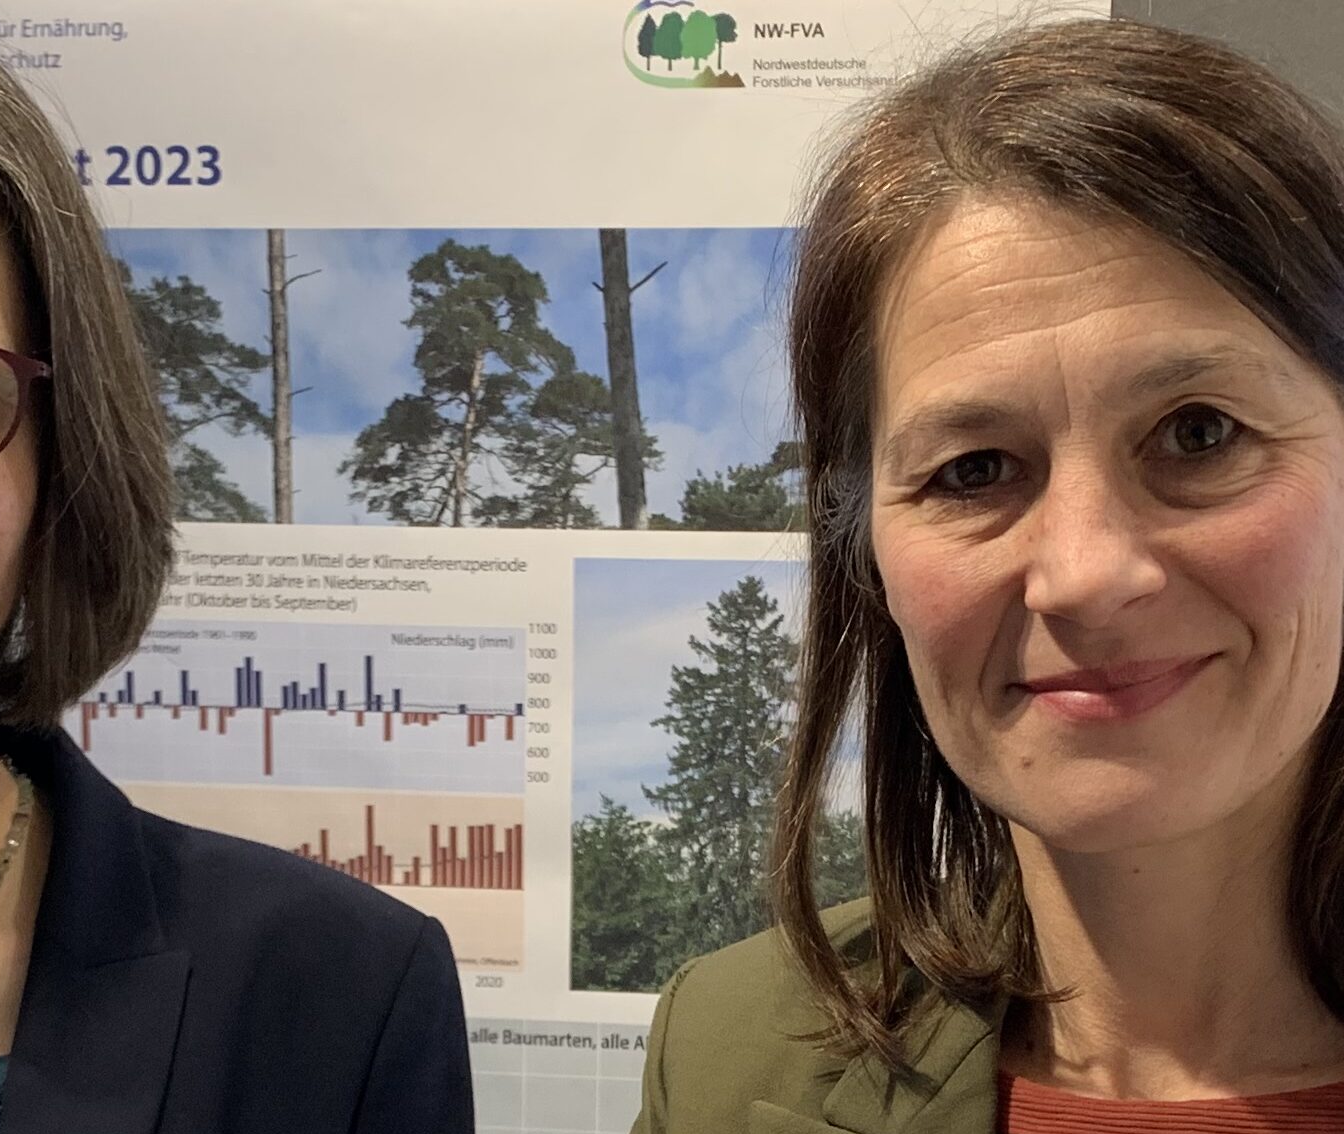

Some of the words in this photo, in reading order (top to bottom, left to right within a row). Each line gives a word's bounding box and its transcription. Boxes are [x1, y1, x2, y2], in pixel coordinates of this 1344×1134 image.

[21, 18, 128, 42] Ernährung,
[754, 22, 825, 39] NW-FVA
[753, 58, 867, 71] Nordwestdeutsche
[753, 75, 813, 88] Forstliche
[105, 145, 223, 187] 2023
[267, 555, 299, 567] vom
[301, 554, 343, 569] Mittel
[346, 554, 370, 569] der
[373, 555, 528, 574] Klimareferenzperiode
[194, 572, 244, 587] letzten
[245, 573, 264, 588] 30
[265, 573, 305, 588] Jahre
[323, 574, 431, 593] Niedersachsen,
[250, 594, 271, 609] bis
[274, 594, 356, 613] September)
[528, 623, 557, 635] 1100
[391, 632, 476, 650] Niederschlag
[479, 634, 515, 650] (mm)
[528, 648, 557, 660] 1000
[527, 672, 551, 685] 900
[527, 697, 551, 710] 800
[527, 722, 550, 734] 700
[527, 747, 550, 759] 600
[527, 771, 550, 783] 500
[475, 976, 504, 989] 2020
[469, 1029, 498, 1044] alle
[502, 1029, 597, 1050] Baumarten,
[601, 1033, 630, 1050] alle
